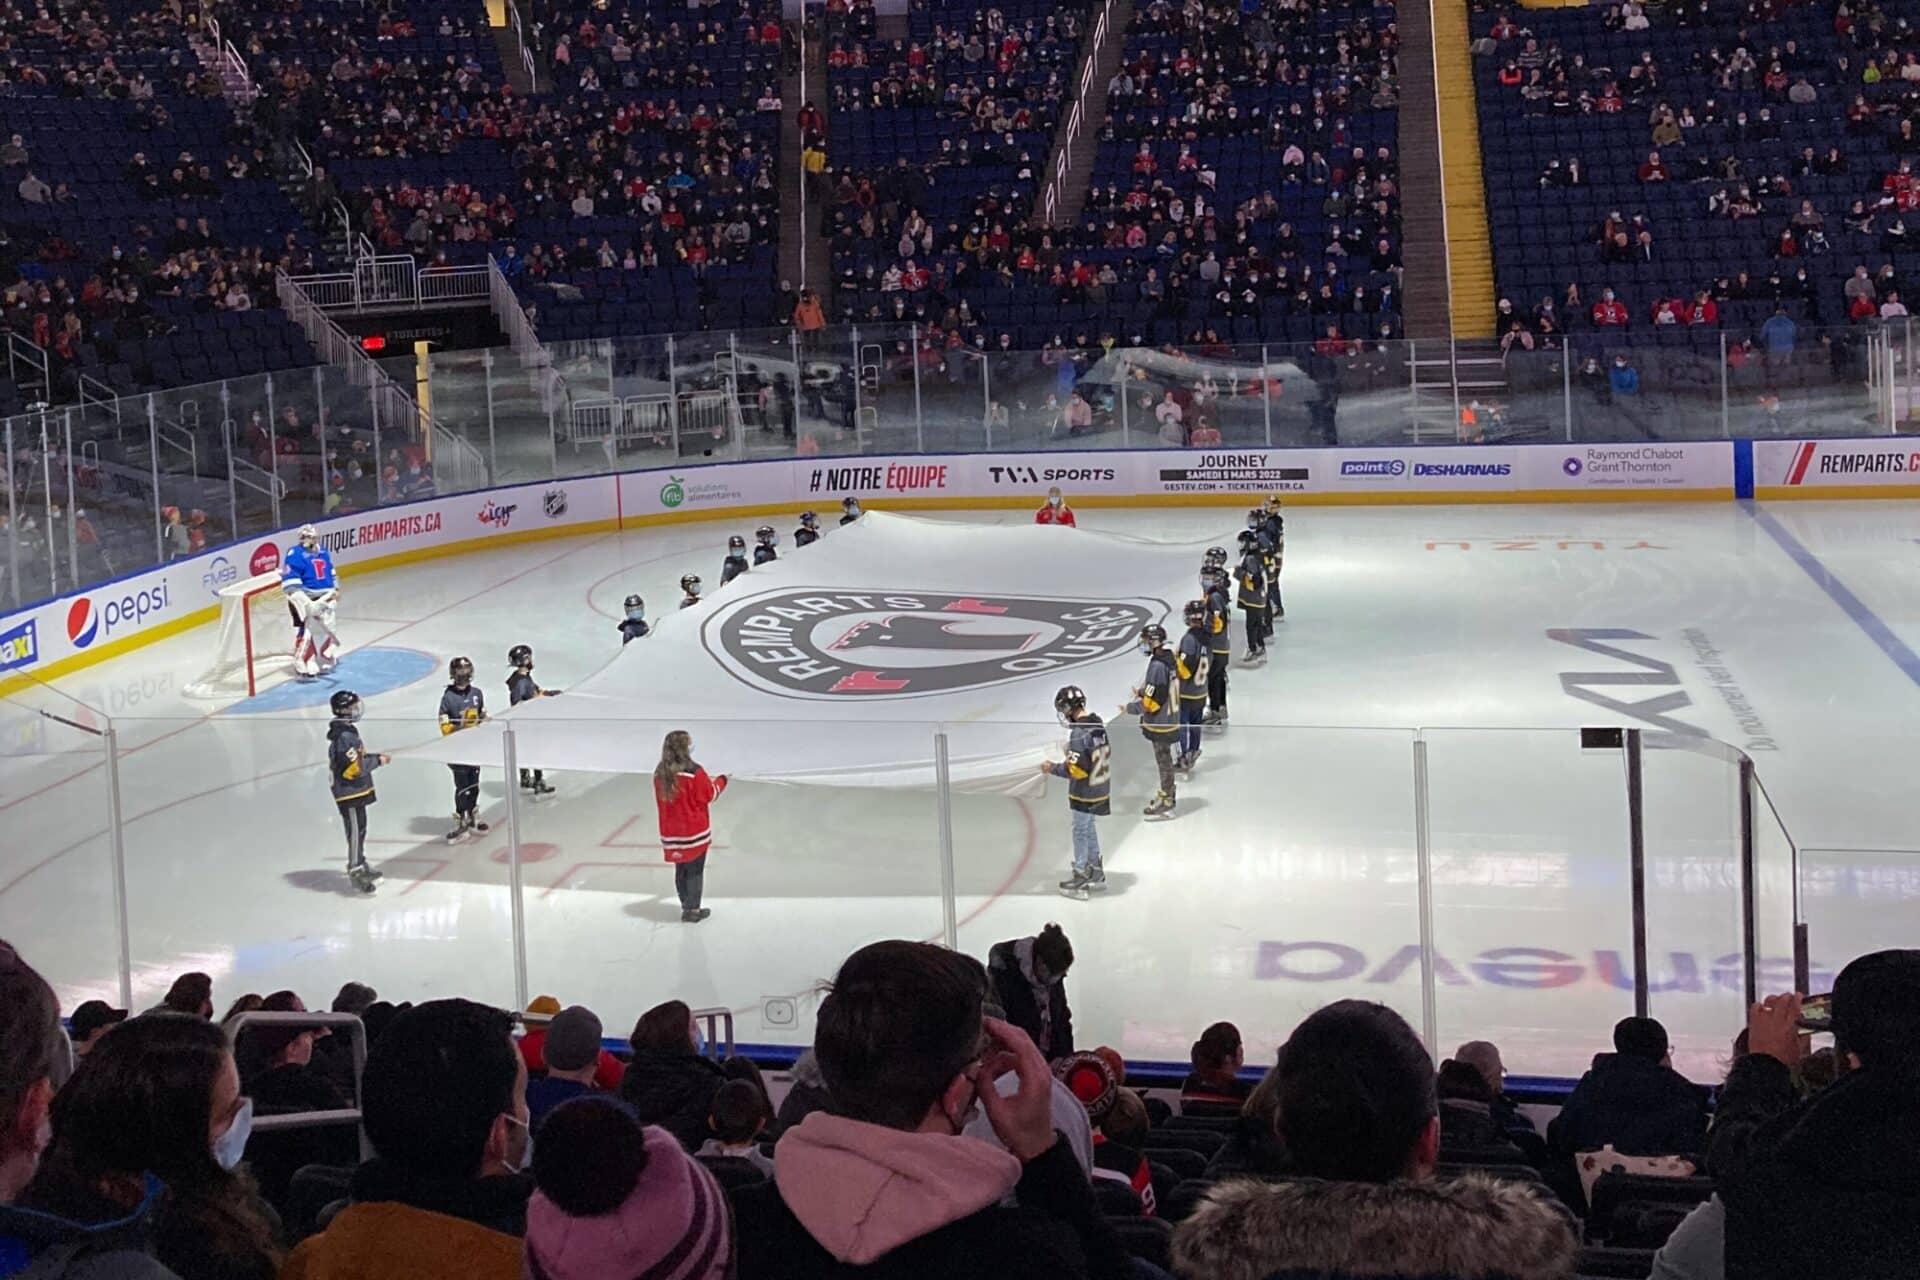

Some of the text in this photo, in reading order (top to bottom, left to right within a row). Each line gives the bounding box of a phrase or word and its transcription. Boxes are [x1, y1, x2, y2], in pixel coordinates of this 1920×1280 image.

[1198, 454, 1268, 468] JOURNEY
[1587, 448, 1684, 462] Raymond Chabot
[1345, 462, 1383, 474] point
[1413, 463, 1512, 476] DESHARNAIS
[1587, 460, 1672, 472] Grant Thornton
[826, 467, 883, 491] NOTRE
[886, 462, 948, 492] ÉQUIPE
[1043, 468, 1115, 482] SPORTS
[1186, 470, 1222, 480] SAMEDI
[1231, 470, 1257, 479] MARS
[1258, 470, 1281, 479] 2022
[1164, 482, 1305, 491] GESTEV.COM TICKETMASTER.CA
[104, 578, 169, 635] pepsi
[0, 625, 34, 664] axi
[739, 594, 926, 681] REMPARTS
